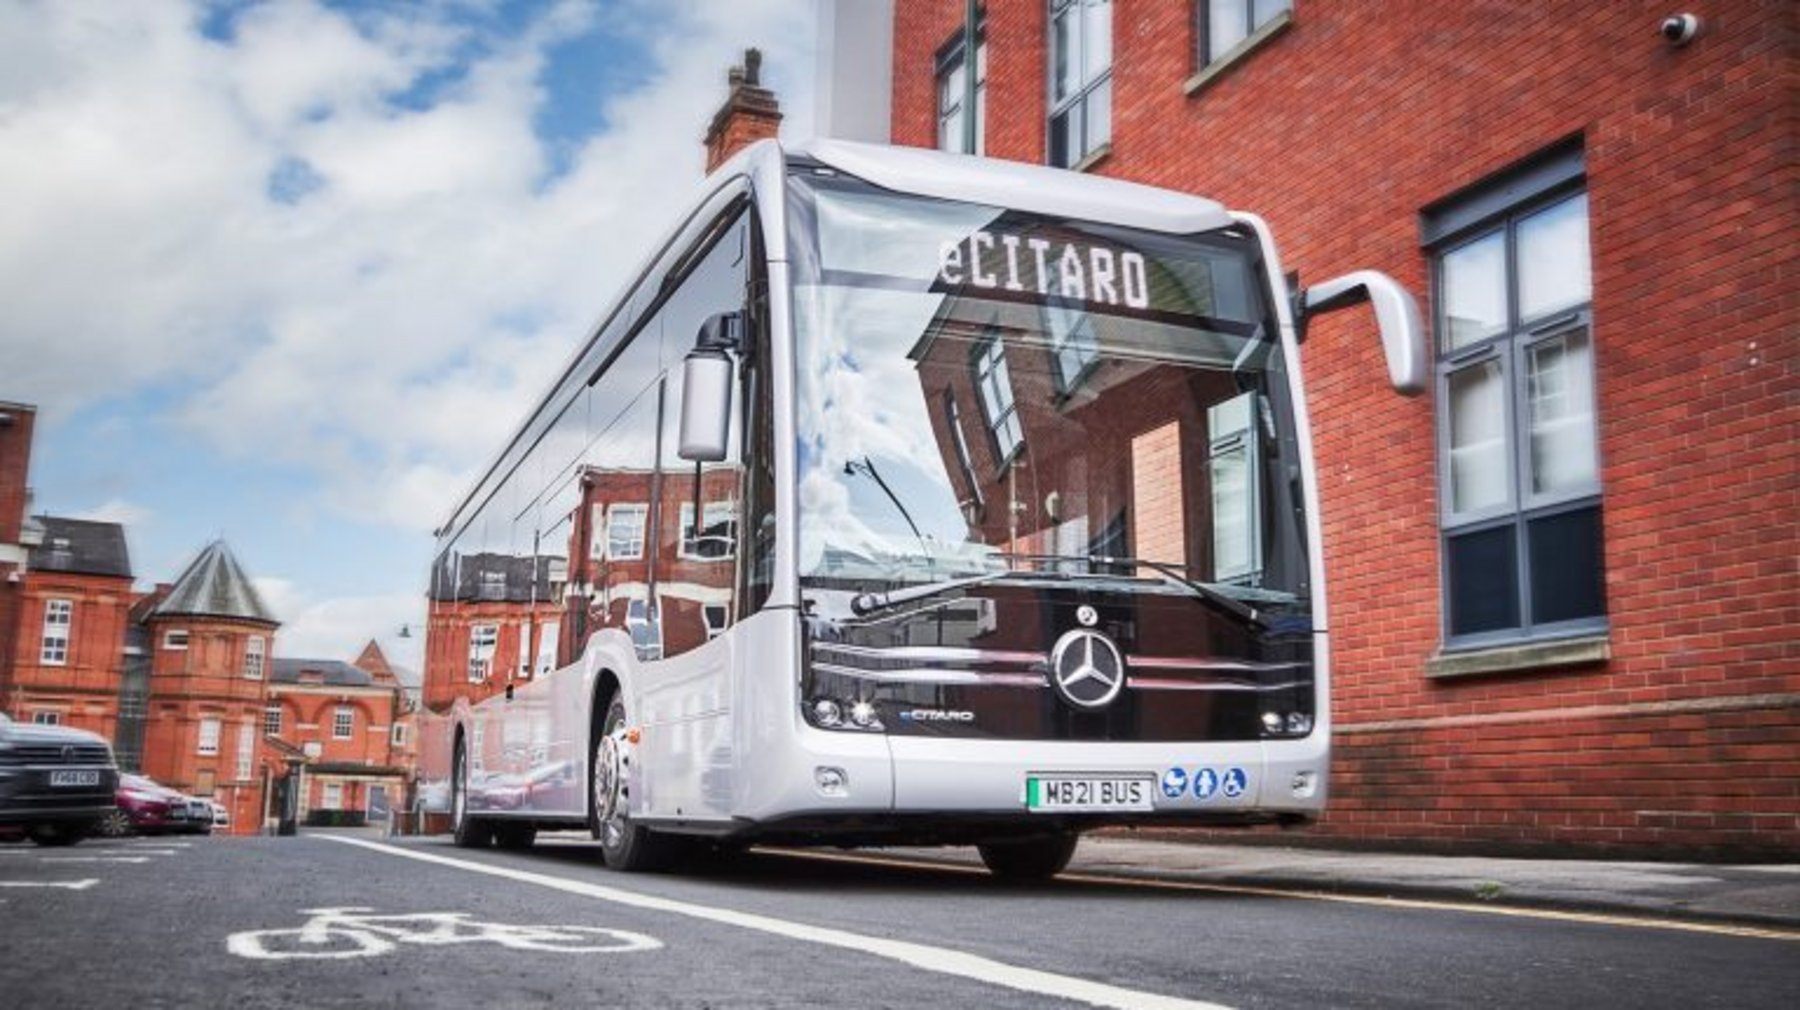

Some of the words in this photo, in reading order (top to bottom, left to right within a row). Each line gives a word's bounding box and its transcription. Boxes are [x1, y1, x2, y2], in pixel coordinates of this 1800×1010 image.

[939, 231, 1148, 308] eCITARO
[1046, 781, 1094, 804] MB21
[1101, 781, 1142, 804] BUS
